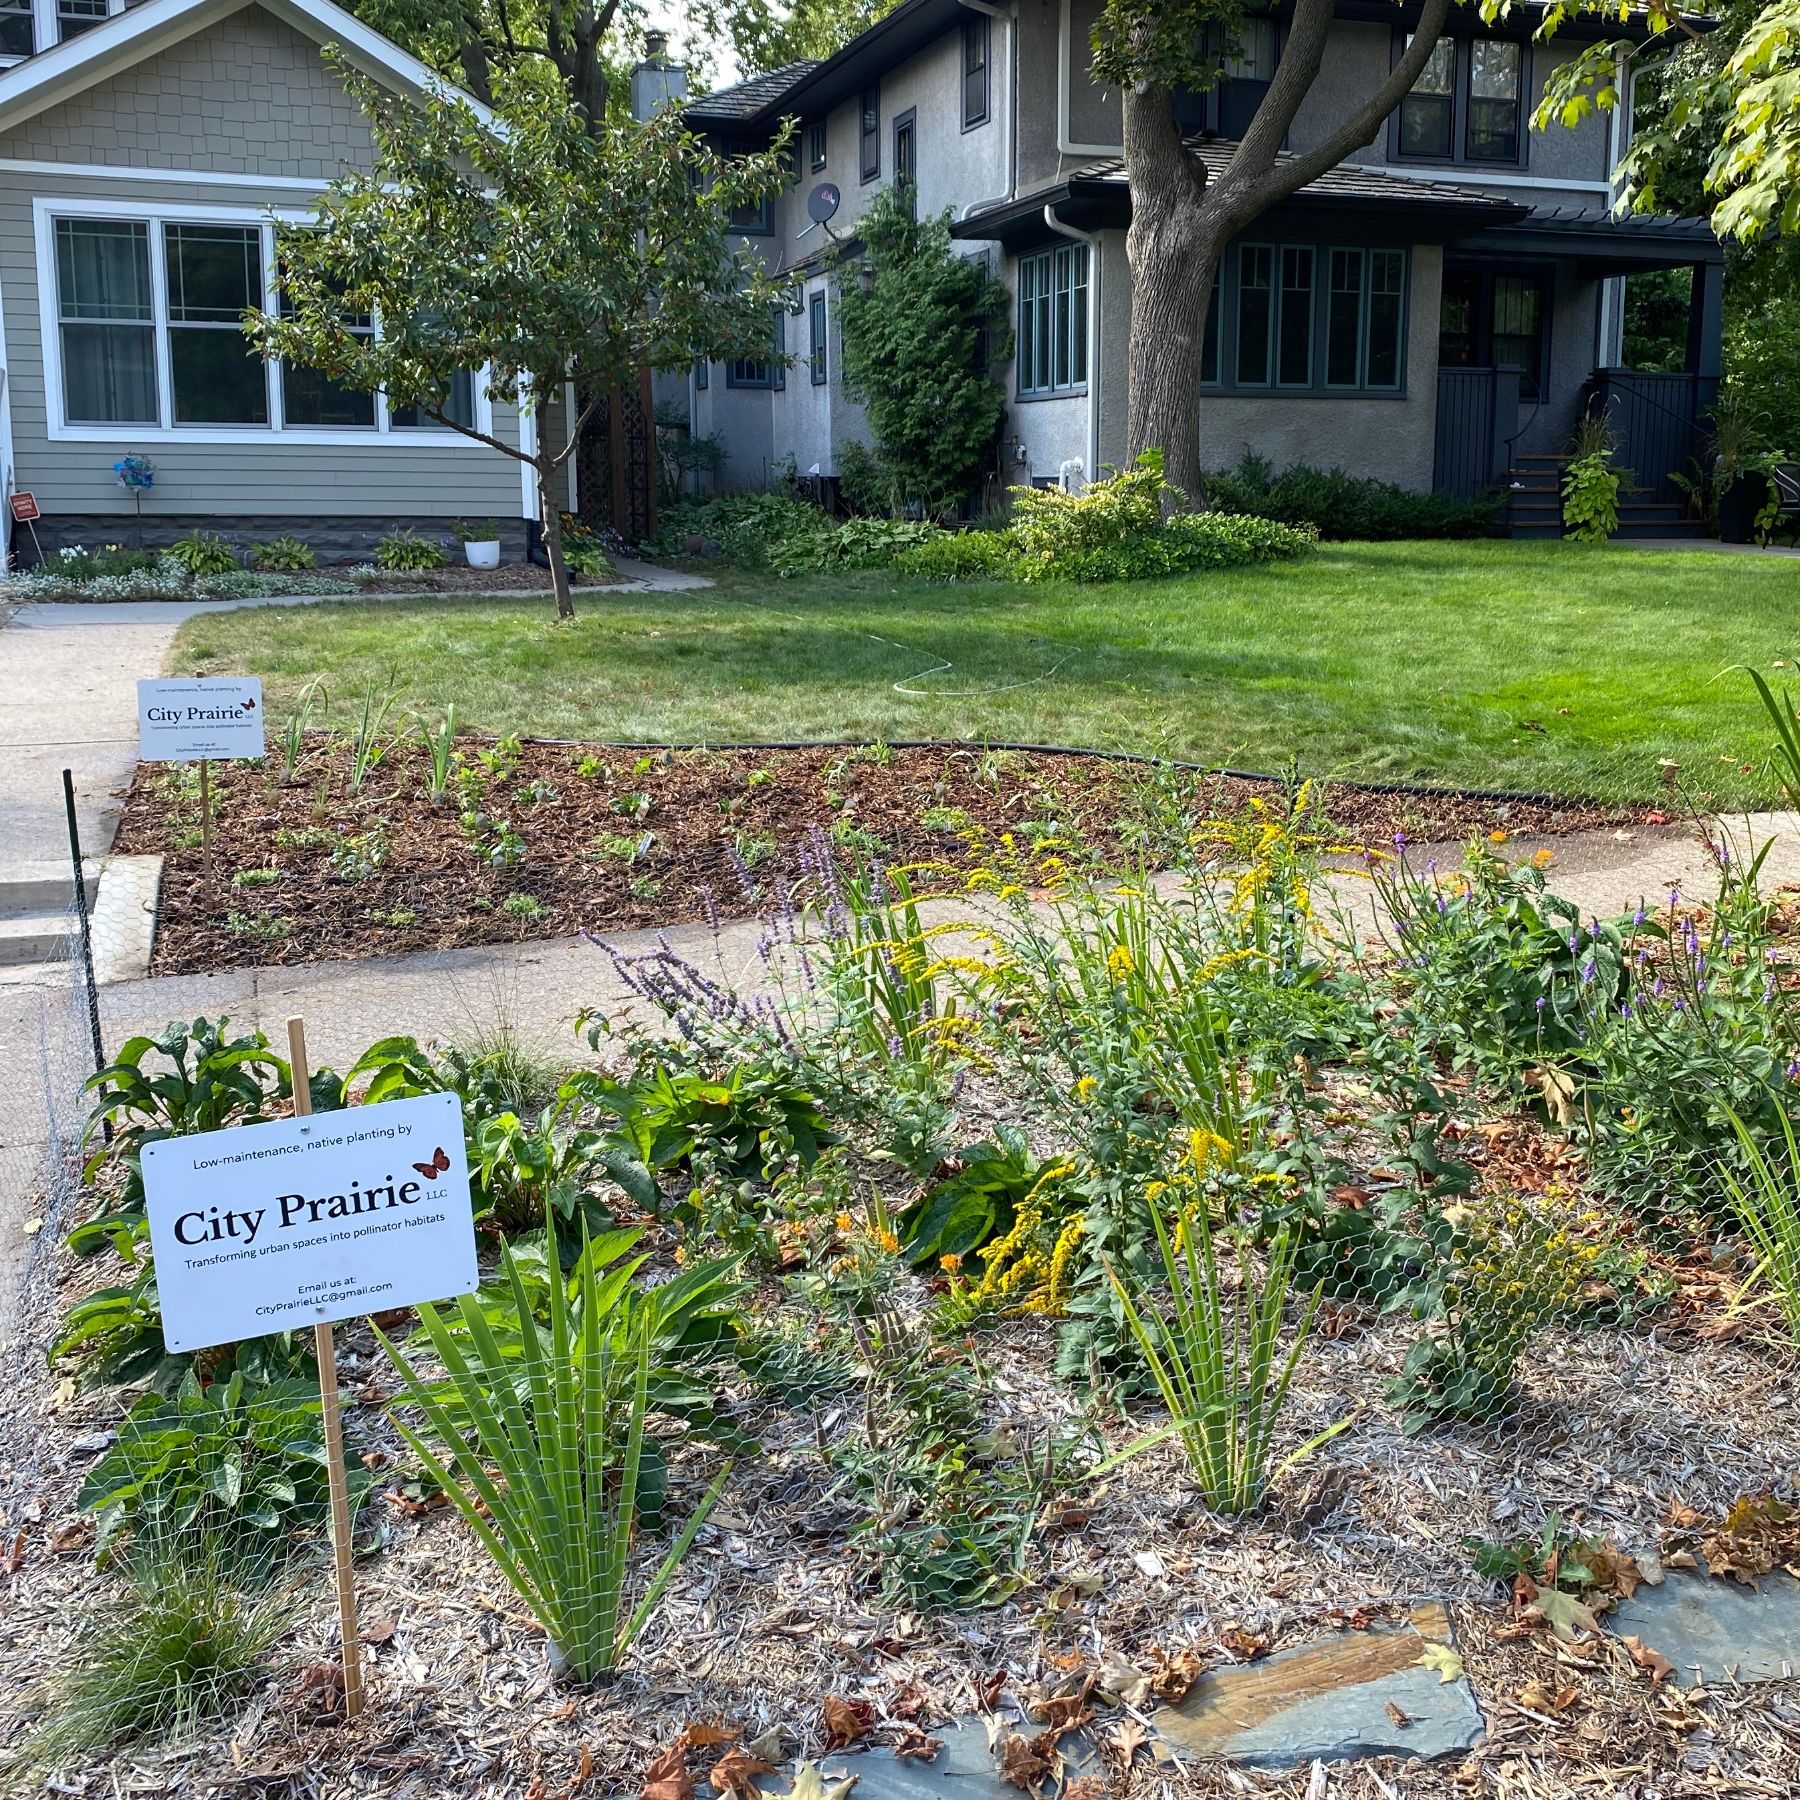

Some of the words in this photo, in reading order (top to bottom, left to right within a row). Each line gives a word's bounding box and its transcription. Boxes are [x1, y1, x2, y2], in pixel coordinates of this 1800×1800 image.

[147, 707, 182, 724] City
[187, 705, 243, 719] Prairie
[193, 1144, 304, 1169] Low-maintenance,
[307, 1137, 343, 1150] native
[346, 1128, 395, 1145] planting
[397, 1124, 412, 1135] by
[174, 1207, 266, 1245] City
[275, 1174, 421, 1227] Prairie
[426, 1189, 447, 1200] LLC
[184, 1249, 257, 1269] Transforming
[259, 1243, 290, 1255] urban
[292, 1236, 328, 1249] spaces
[330, 1231, 351, 1241] into
[353, 1221, 402, 1239] pollinator
[404, 1213, 445, 1227] habitats
[255, 1282, 393, 1315] CityPrairieLLC@gmail.com
[298, 1281, 327, 1294] Email
[329, 1280, 342, 1288] us
[344, 1276, 357, 1285] at:
